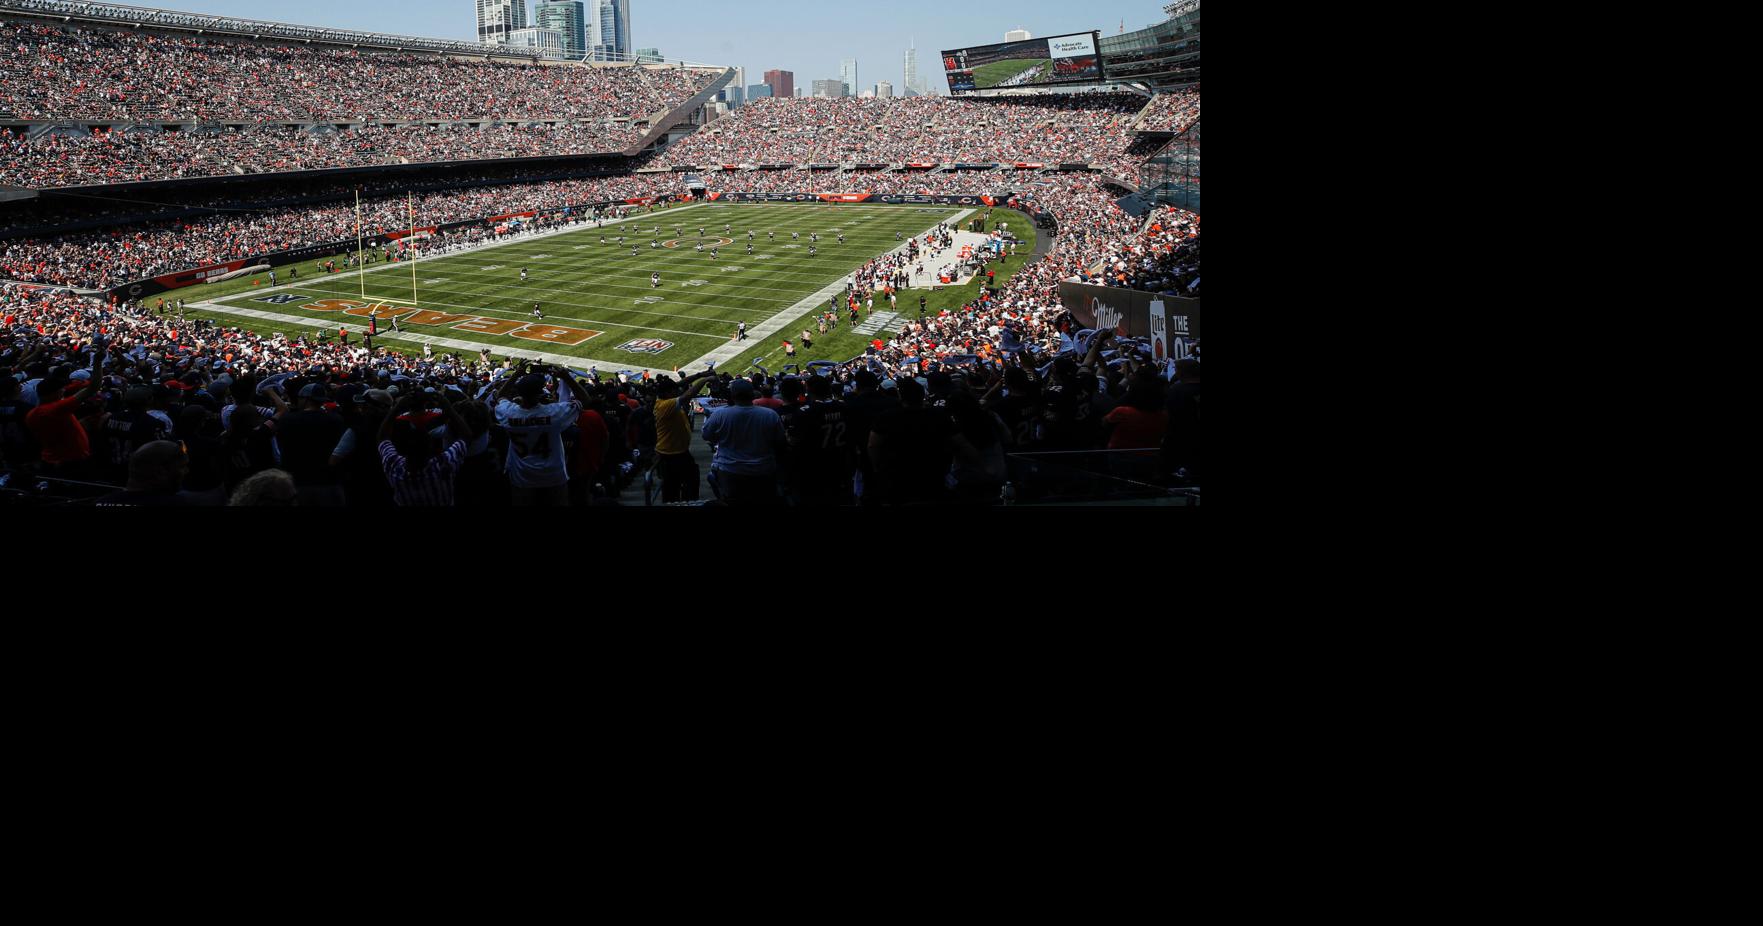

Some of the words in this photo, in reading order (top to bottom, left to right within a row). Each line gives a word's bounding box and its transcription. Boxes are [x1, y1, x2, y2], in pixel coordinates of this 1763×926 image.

[298, 298, 604, 346] BEARS
[1091, 296, 1124, 330] Miller
[1172, 315, 1189, 332] THE
[820, 421, 847, 449] 72
